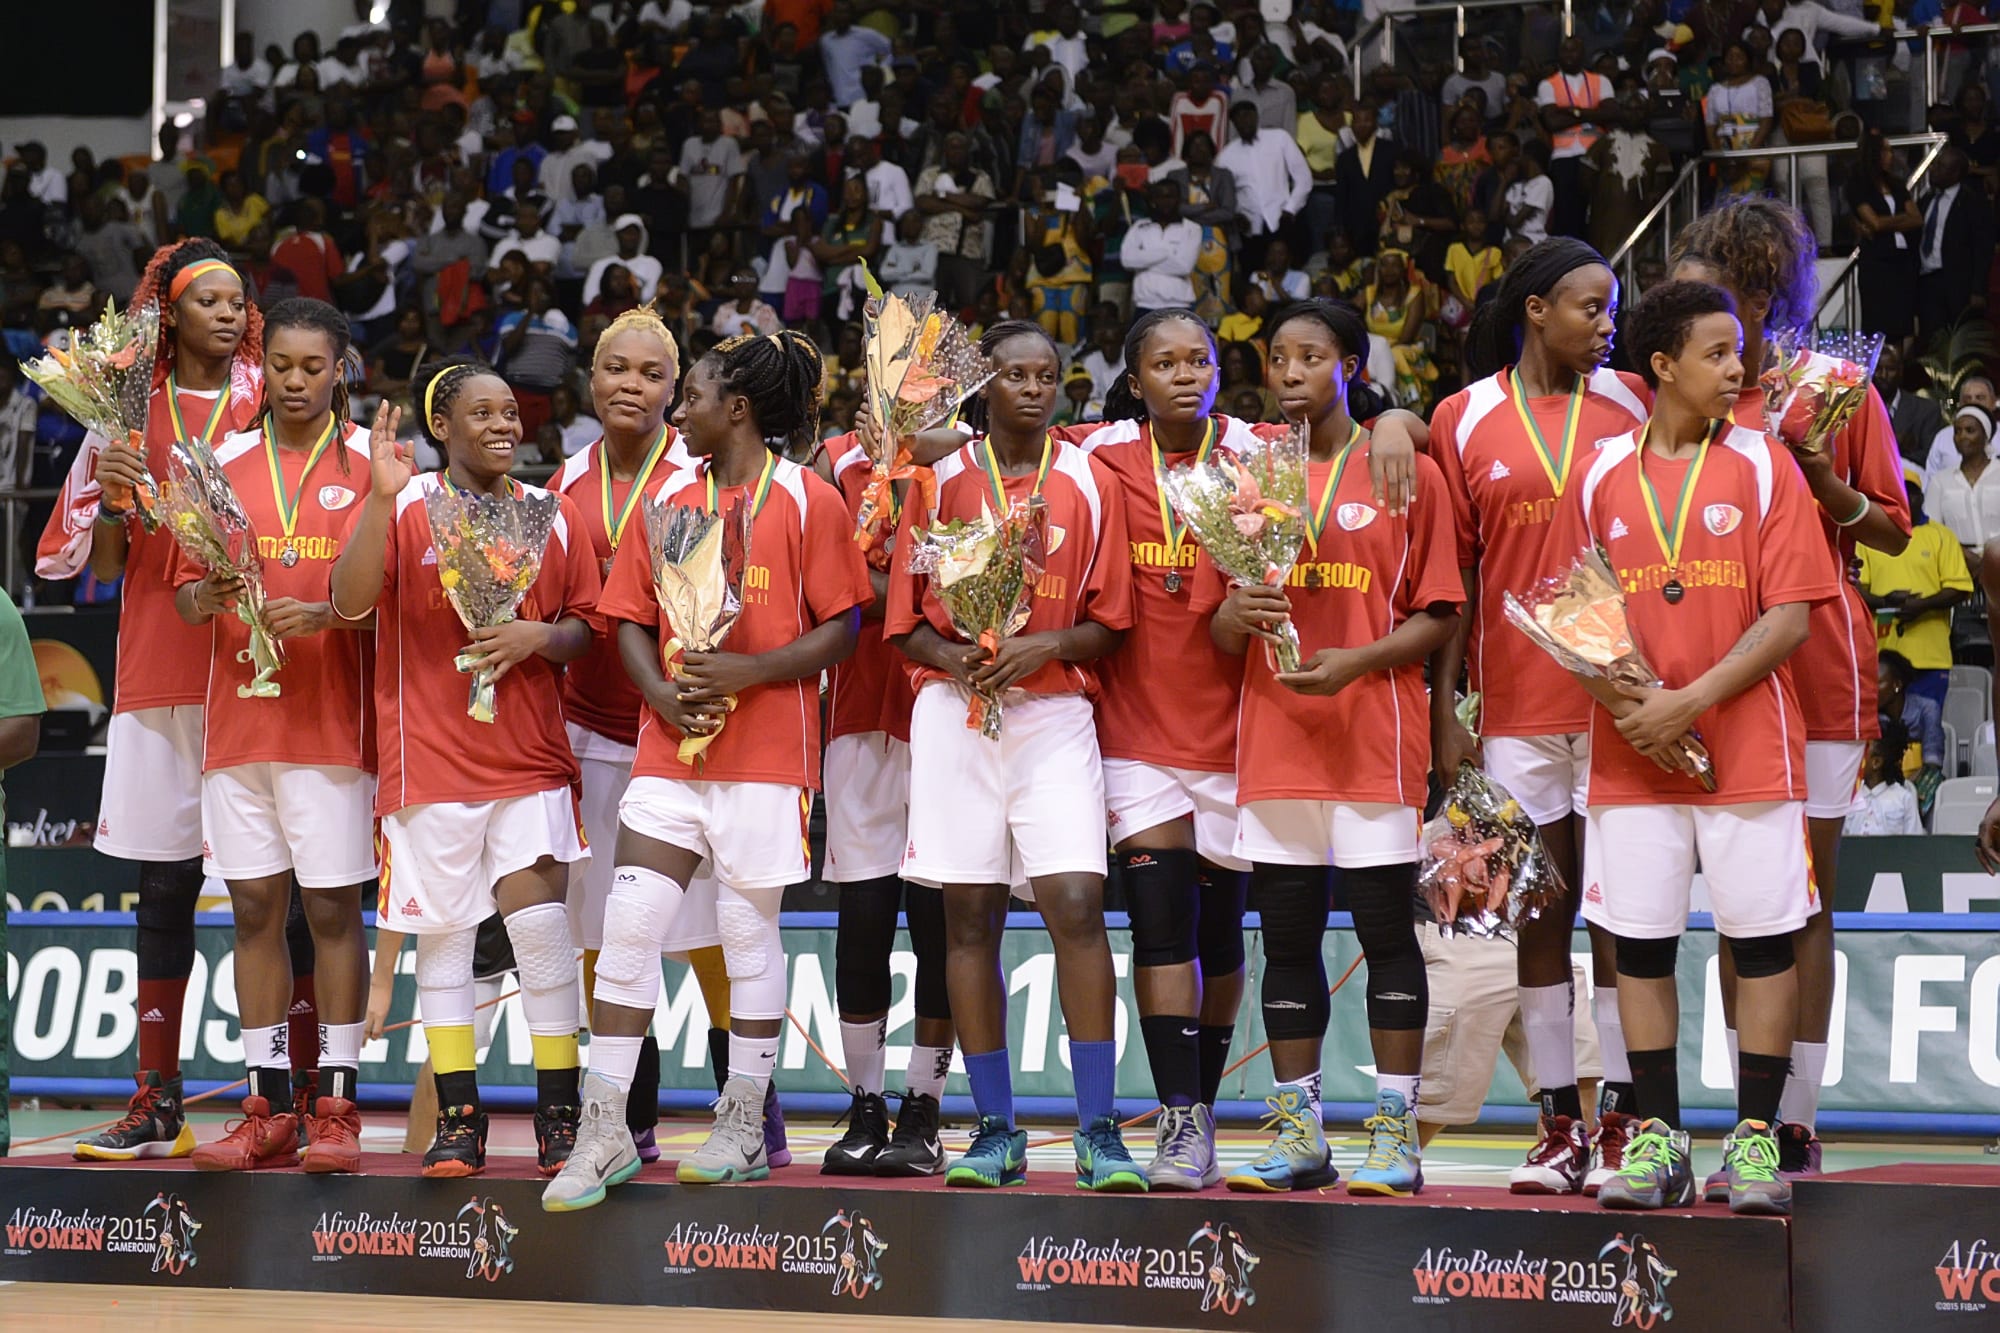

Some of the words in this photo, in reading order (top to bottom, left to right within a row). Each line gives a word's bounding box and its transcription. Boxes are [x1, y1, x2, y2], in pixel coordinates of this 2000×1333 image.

[7, 1206, 107, 1233] AfroBasket
[107, 1217, 157, 1240] 2015
[312, 1211, 418, 1240] AfroBasket
[5, 1225, 105, 1251] WOMEN
[107, 1241, 156, 1253] CAMEROUN
[312, 1231, 416, 1256] WOMEN
[419, 1221, 471, 1246] 2015
[664, 1222, 780, 1251] AfroBasket
[419, 1246, 471, 1259] CAMEROUN
[664, 1241, 778, 1270] WOMEN
[782, 1234, 837, 1261] 2015
[1018, 1235, 1143, 1267] AfroBasket
[782, 1261, 837, 1275] CAMEROUN
[1017, 1256, 1141, 1287] WOMEN
[1144, 1248, 1205, 1276] 2015
[1413, 1246, 1548, 1280] AfroBasket
[1551, 1260, 1617, 1289] 2015
[1144, 1276, 1205, 1290] CAMEROUN
[1412, 1268, 1546, 1300] WOMEN
[1551, 1289, 1618, 1304] CAMEROUN
